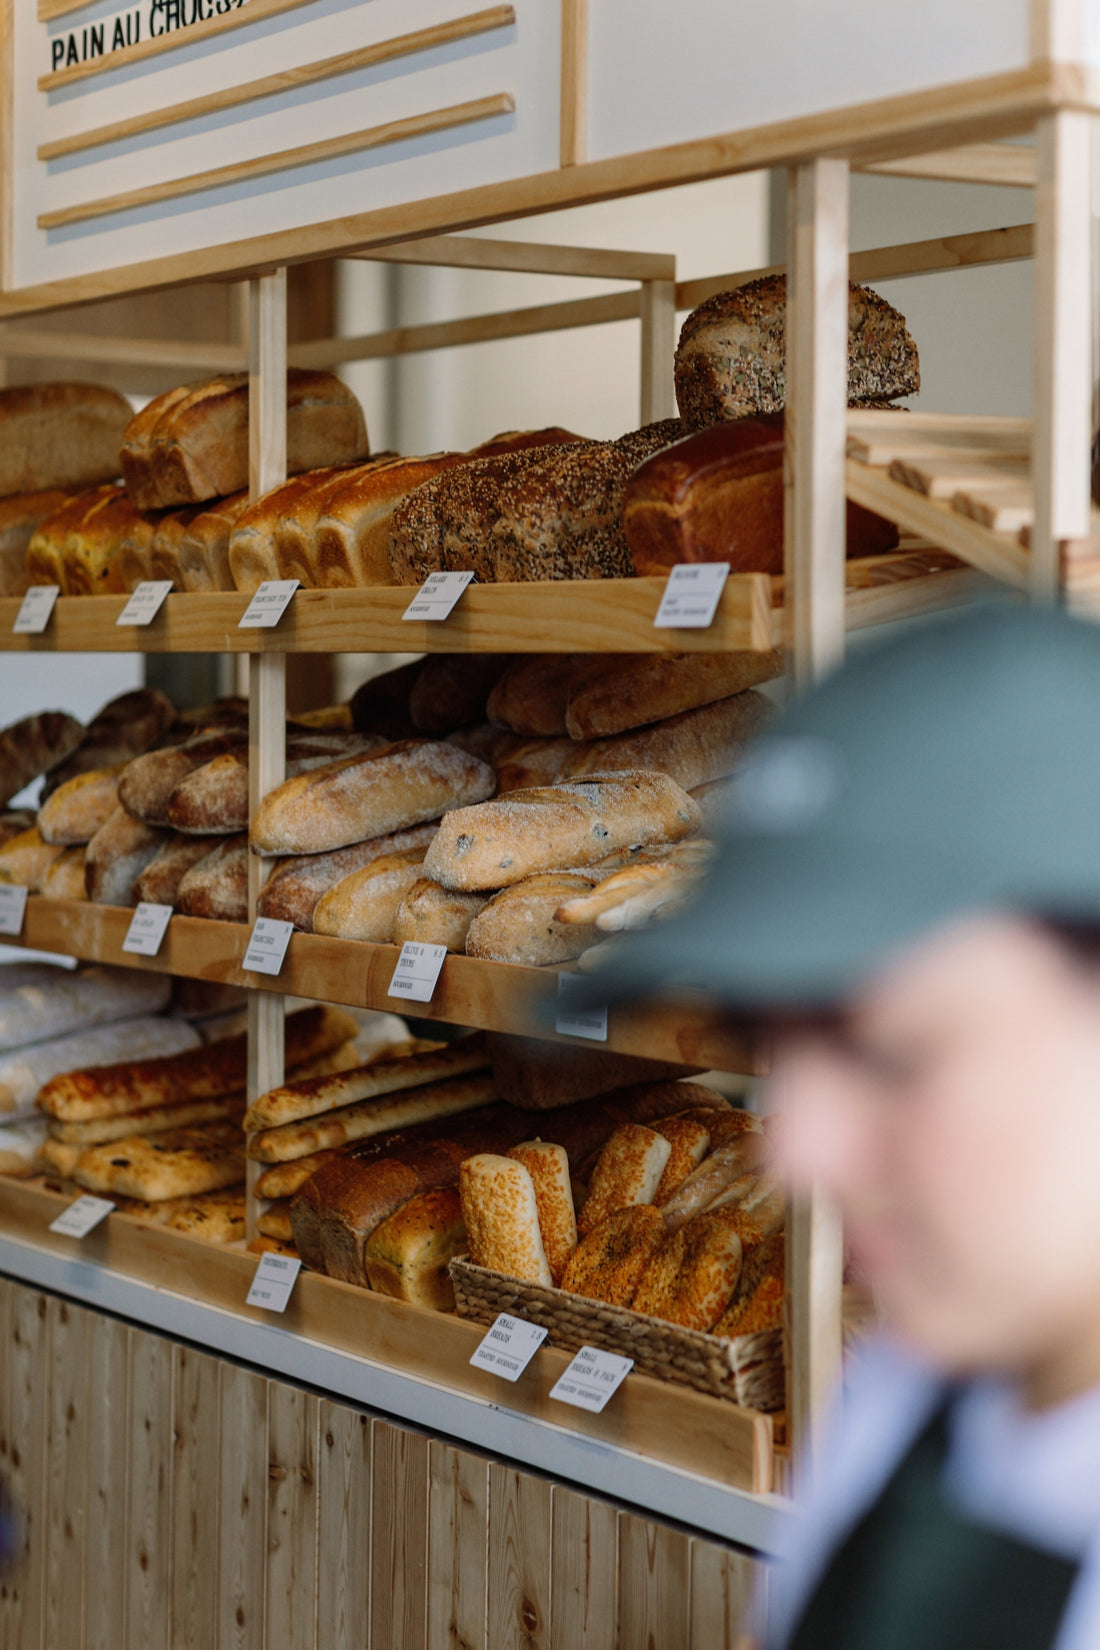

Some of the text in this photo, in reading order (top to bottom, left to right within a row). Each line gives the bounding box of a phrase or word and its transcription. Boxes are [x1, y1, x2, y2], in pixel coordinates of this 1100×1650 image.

[51, 23, 104, 71] PAIN
[112, 11, 140, 51] AU
[403, 945, 419, 956] OLIVE
[497, 1318, 515, 1330] SMALL
[490, 1329, 512, 1343] BREADS
